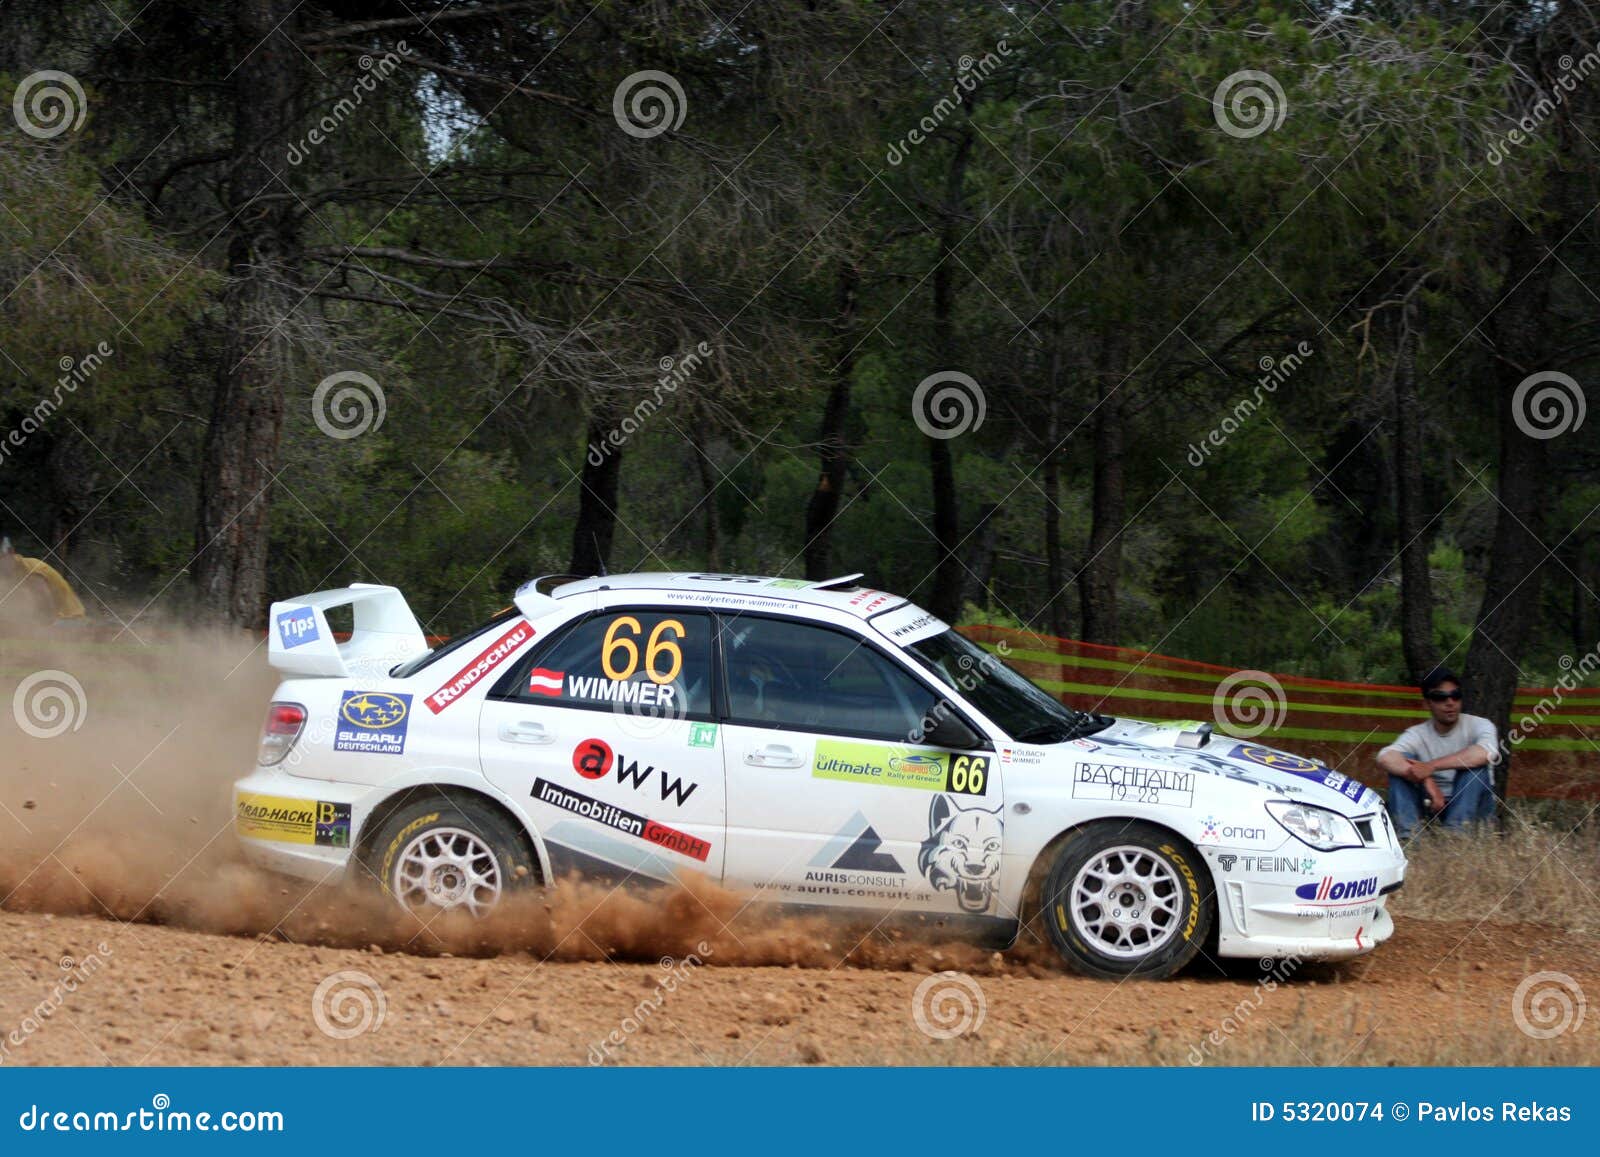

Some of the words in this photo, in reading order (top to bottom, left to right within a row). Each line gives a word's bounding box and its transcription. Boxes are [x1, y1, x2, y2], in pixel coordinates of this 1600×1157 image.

[280, 616, 315, 638] Tips
[602, 616, 686, 685] 66
[432, 628, 527, 707] RUNDSCHAU
[568, 675, 675, 707] WIMMER
[337, 741, 402, 753] DEUTSCHLAND
[338, 731, 403, 744] SUBARU
[816, 759, 883, 777] ultimate
[952, 756, 985, 794] 66
[1080, 763, 1189, 791] BACHHALM
[540, 782, 643, 836] Immobilien
[648, 825, 704, 857] GmbH
[805, 871, 907, 888] AURISCONSULT
[1241, 856, 1299, 873] TEIN
[1158, 844, 1200, 942] SCORPION
